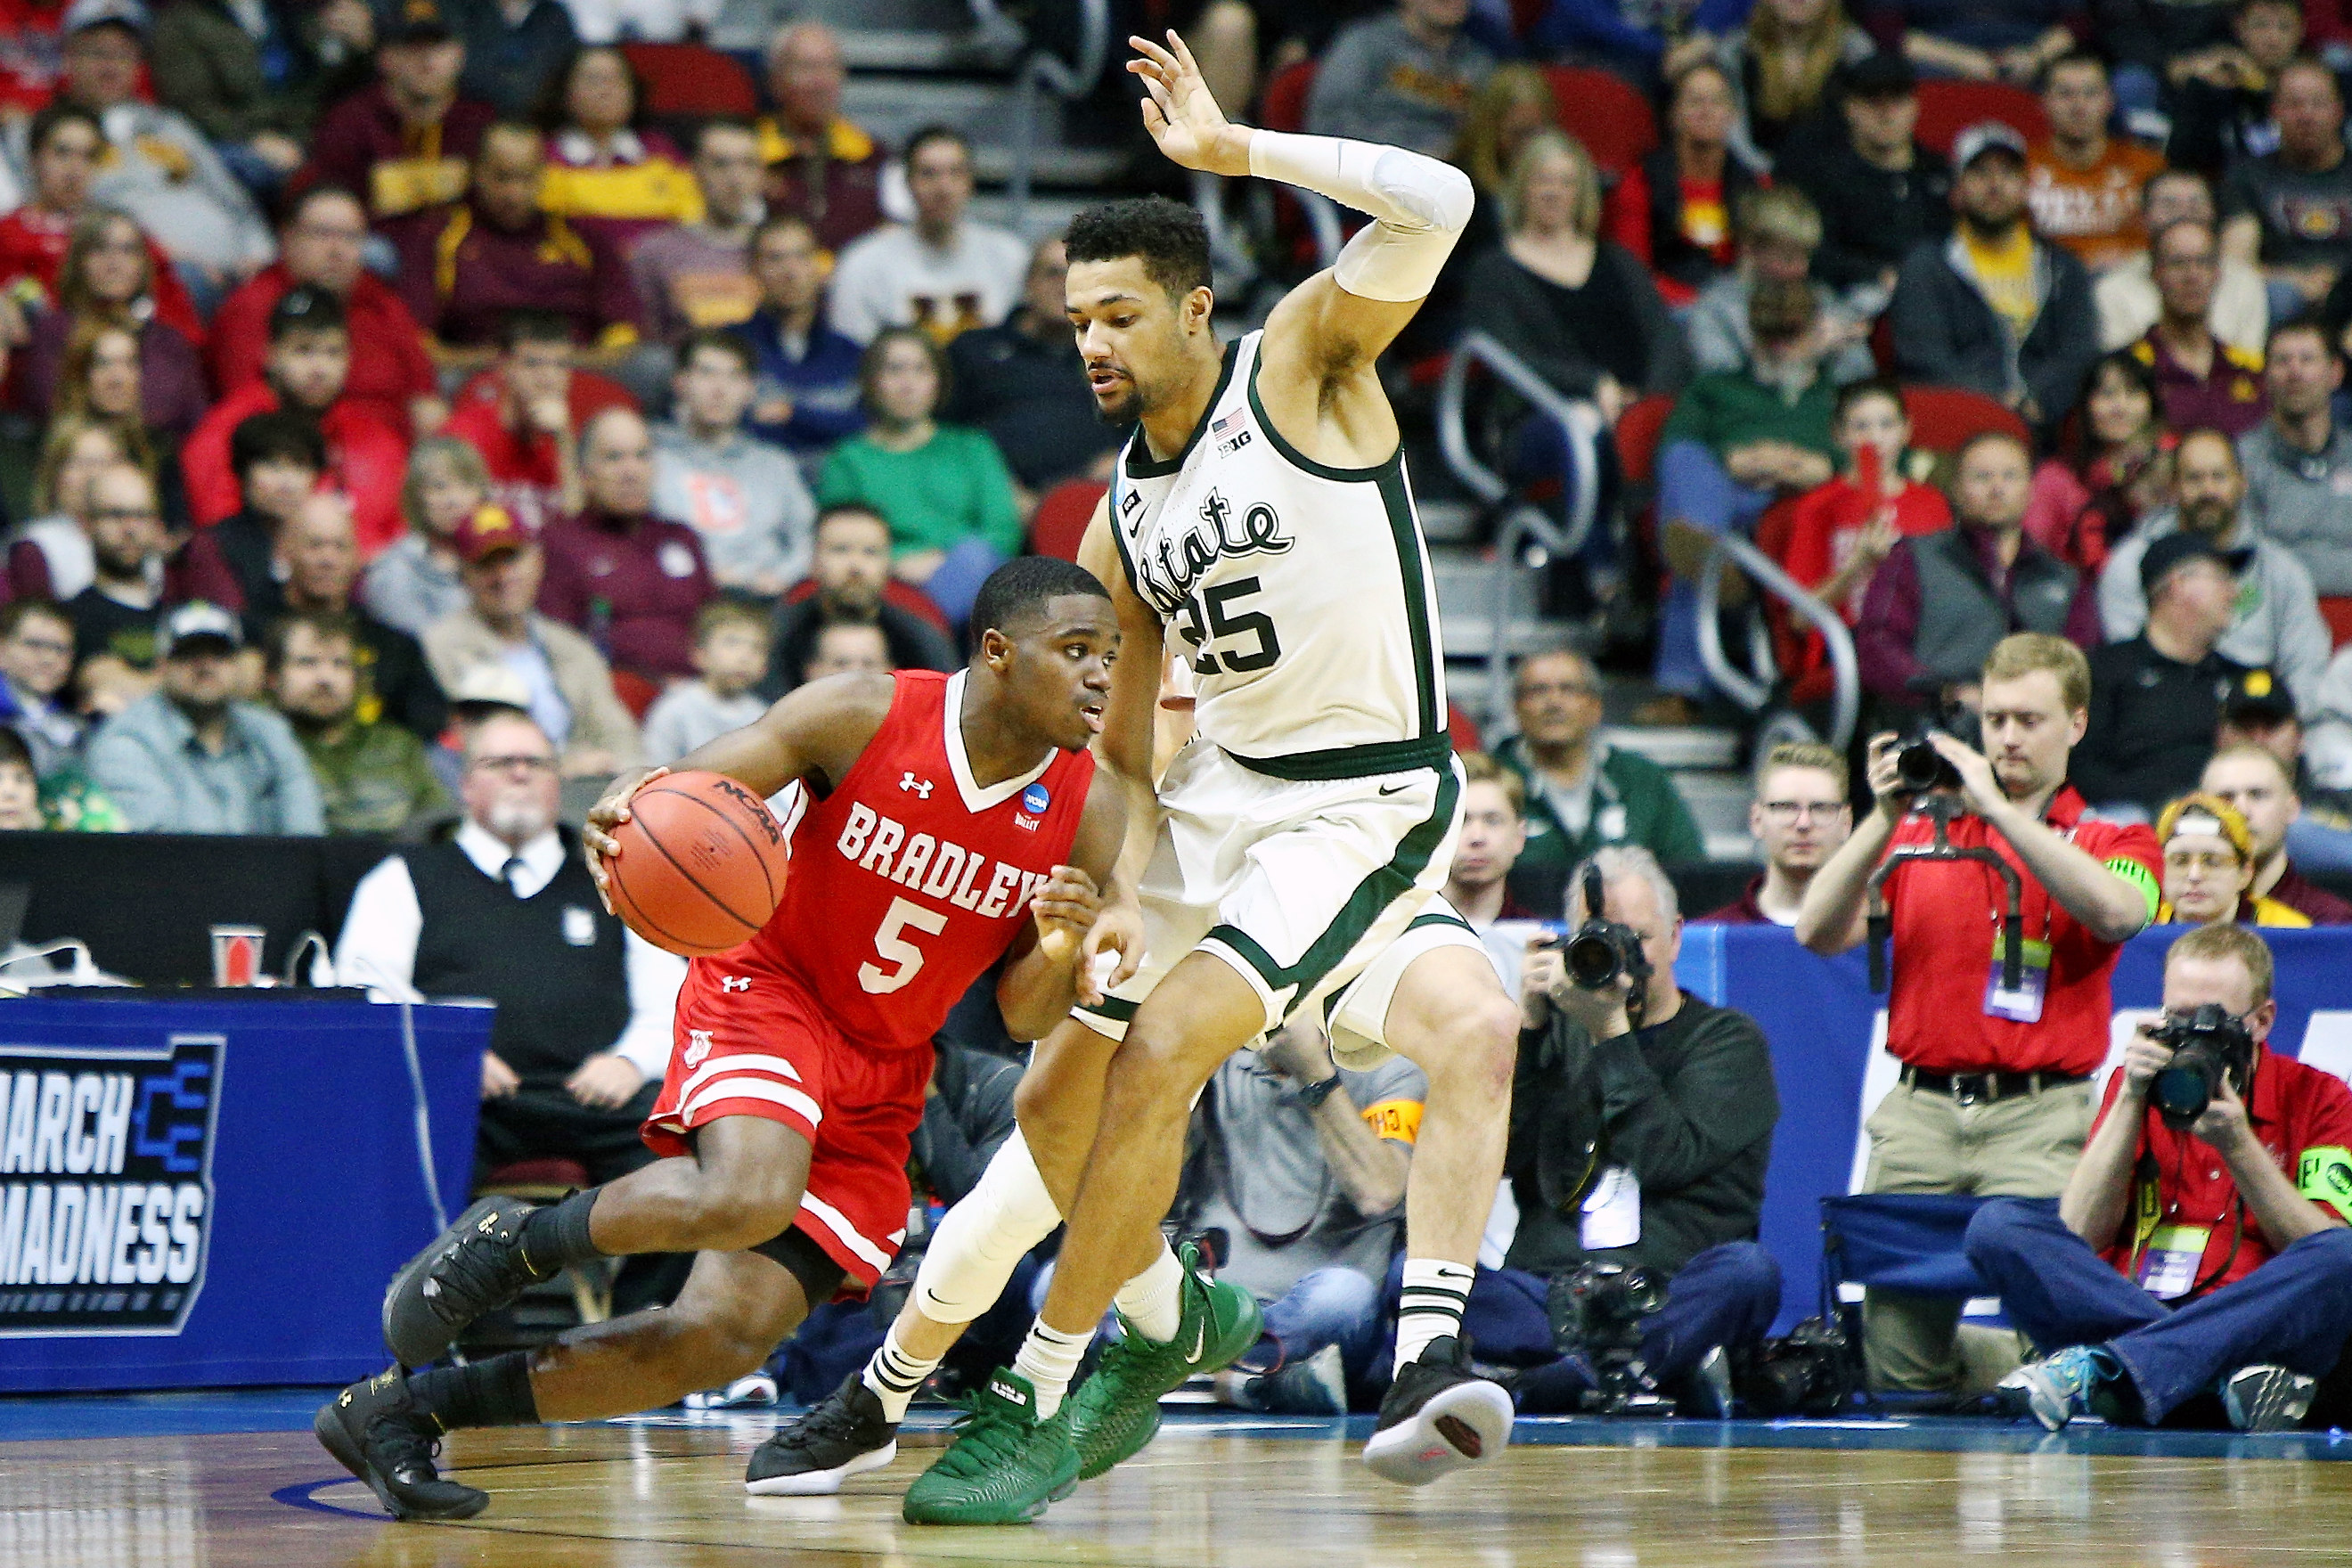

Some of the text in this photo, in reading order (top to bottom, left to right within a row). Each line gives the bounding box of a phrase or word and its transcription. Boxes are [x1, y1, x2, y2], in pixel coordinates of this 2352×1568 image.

[1173, 576, 1282, 675] 25
[712, 780, 780, 845] NCAA
[837, 801, 1049, 919] BRADLEY
[858, 895, 949, 994] 5
